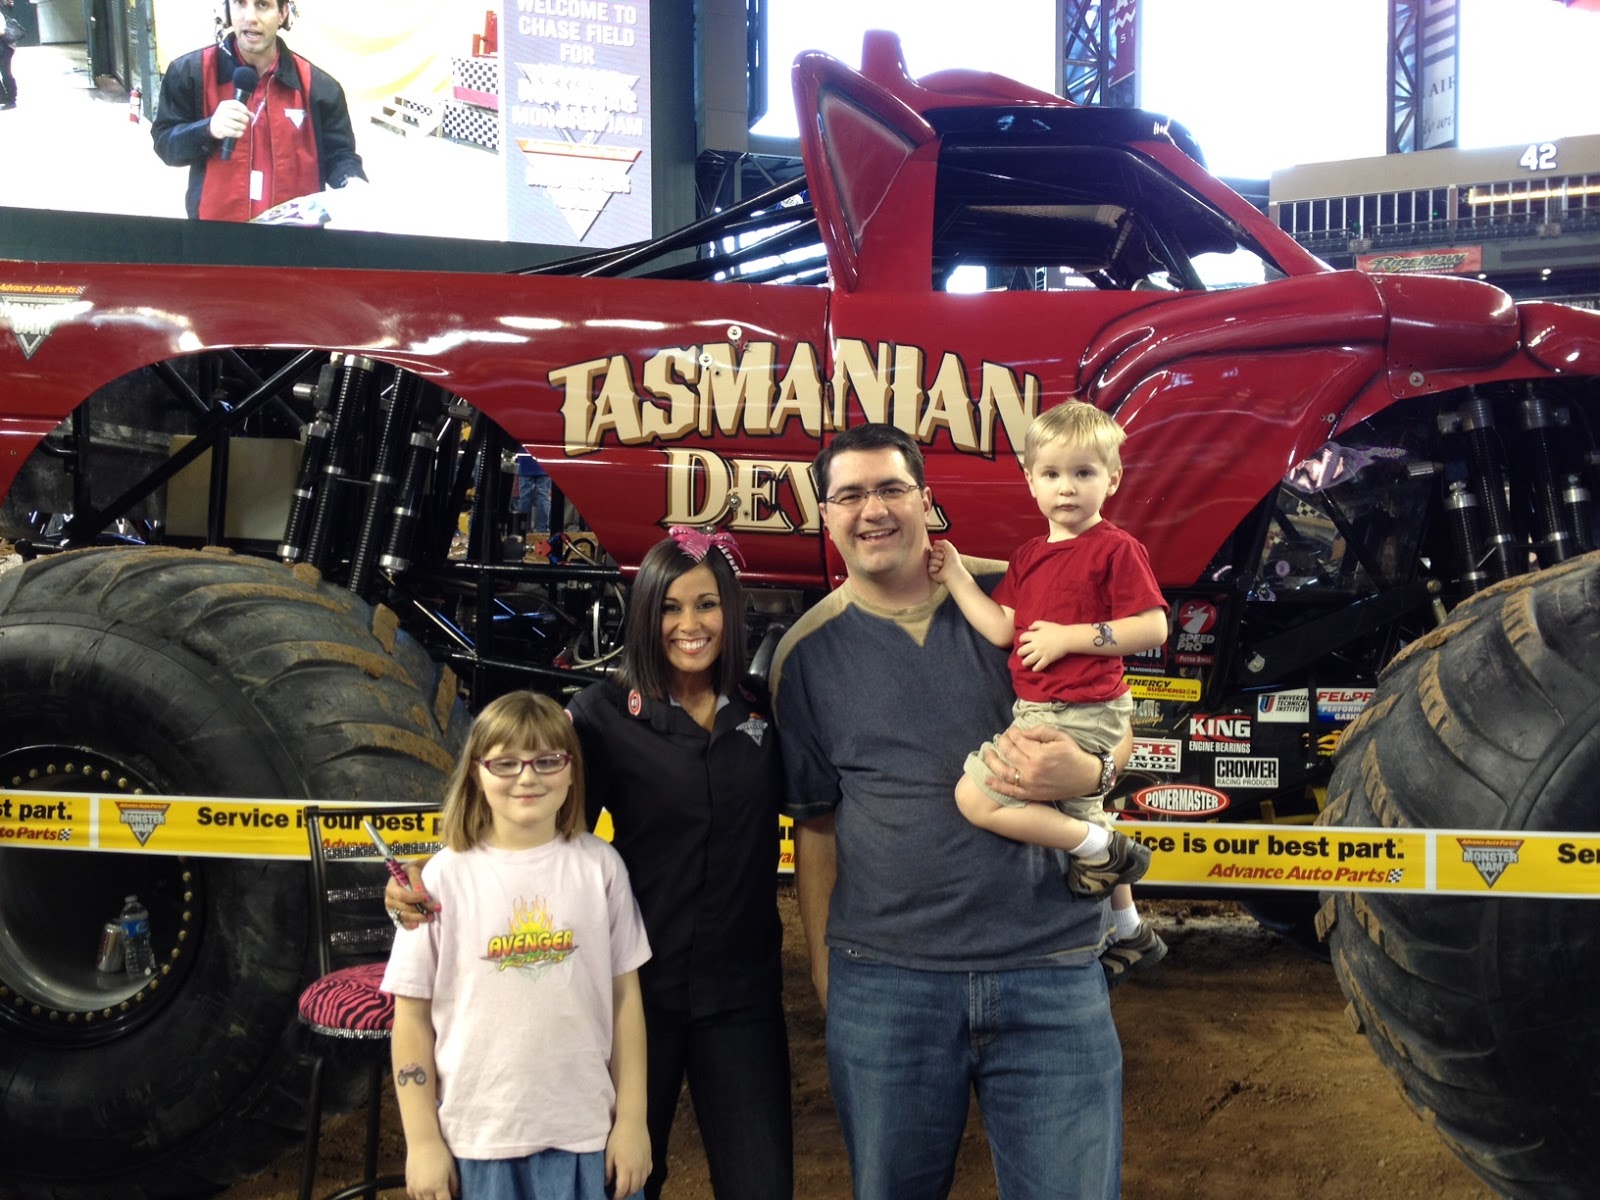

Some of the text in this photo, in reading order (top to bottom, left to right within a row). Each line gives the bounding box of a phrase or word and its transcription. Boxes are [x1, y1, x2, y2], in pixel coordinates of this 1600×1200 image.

[518, 0, 637, 25] WELCOME TO
[519, 15, 635, 47] CHASE FIELD
[560, 42, 595, 65] FOR
[1520, 143, 1557, 170] 42
[0, 284, 76, 294] Advance Auto Parts
[547, 338, 1041, 474] TASMANIAN
[1176, 640, 1203, 652] PRO
[1179, 633, 1215, 644] SPEED
[1127, 679, 1171, 687] ENERGY
[1317, 692, 1374, 702] FEL-PR
[1321, 705, 1361, 713] PERFORM
[1190, 718, 1251, 738] KING
[1189, 741, 1251, 754] ENGINE BEARINGS
[1217, 761, 1277, 778] CROWER
[1145, 789, 1218, 811] POWERMASTER
[19, 801, 73, 822] part.
[120, 813, 165, 824] MONSTER
[197, 806, 289, 828] Service
[323, 815, 363, 830] our
[371, 814, 424, 831] best
[0, 826, 57, 841] to Parts
[131, 823, 153, 833] JAM
[1183, 833, 1207, 853] is
[1214, 838, 1259, 855] our
[1268, 835, 1329, 857] best
[1338, 838, 1404, 861] part.
[1463, 851, 1518, 862] MONSTER
[1207, 863, 1385, 883] Advance Auto Parts
[1477, 861, 1503, 872] JAM
[487, 929, 574, 959] AVENGER
